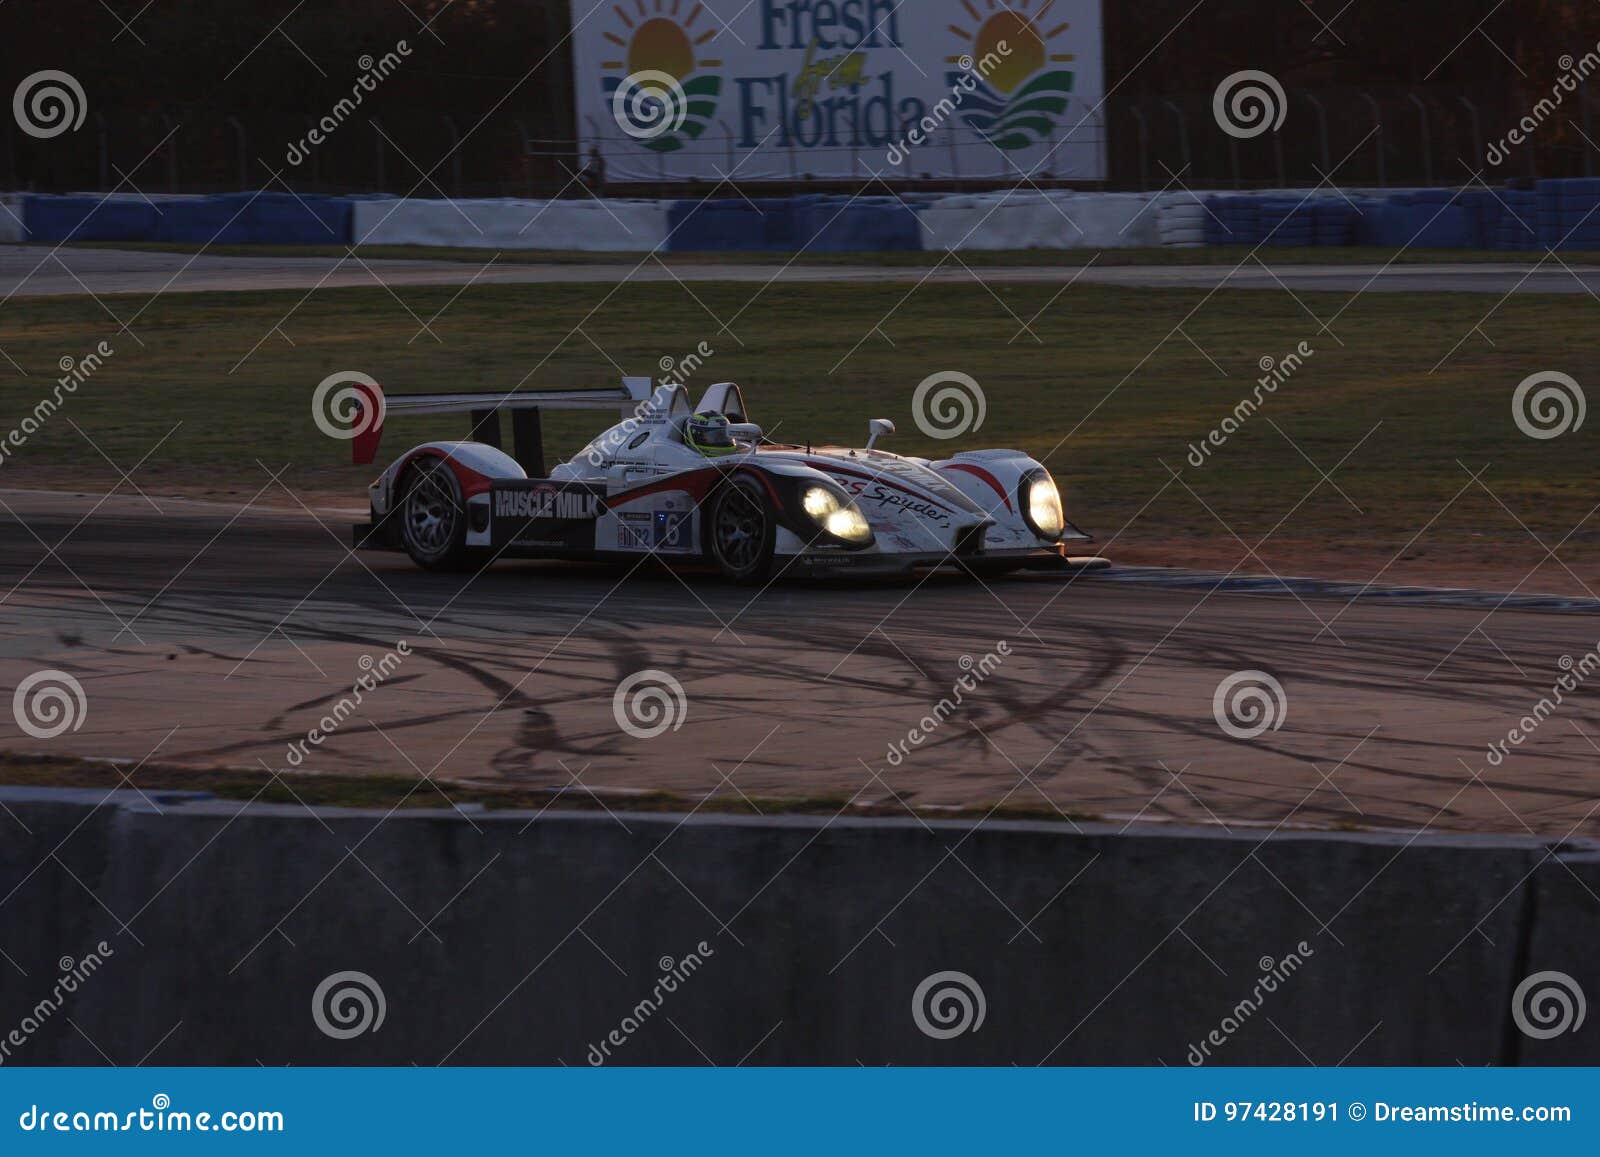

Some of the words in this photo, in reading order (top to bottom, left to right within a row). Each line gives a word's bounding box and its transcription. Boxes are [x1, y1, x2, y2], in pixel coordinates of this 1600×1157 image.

[757, 0, 904, 49] Fresh
[734, 71, 933, 148] Florida
[495, 489, 553, 518] MUSCLE
[556, 491, 600, 519] MILK
[863, 486, 948, 520] Spyder
[665, 513, 680, 546] 6
